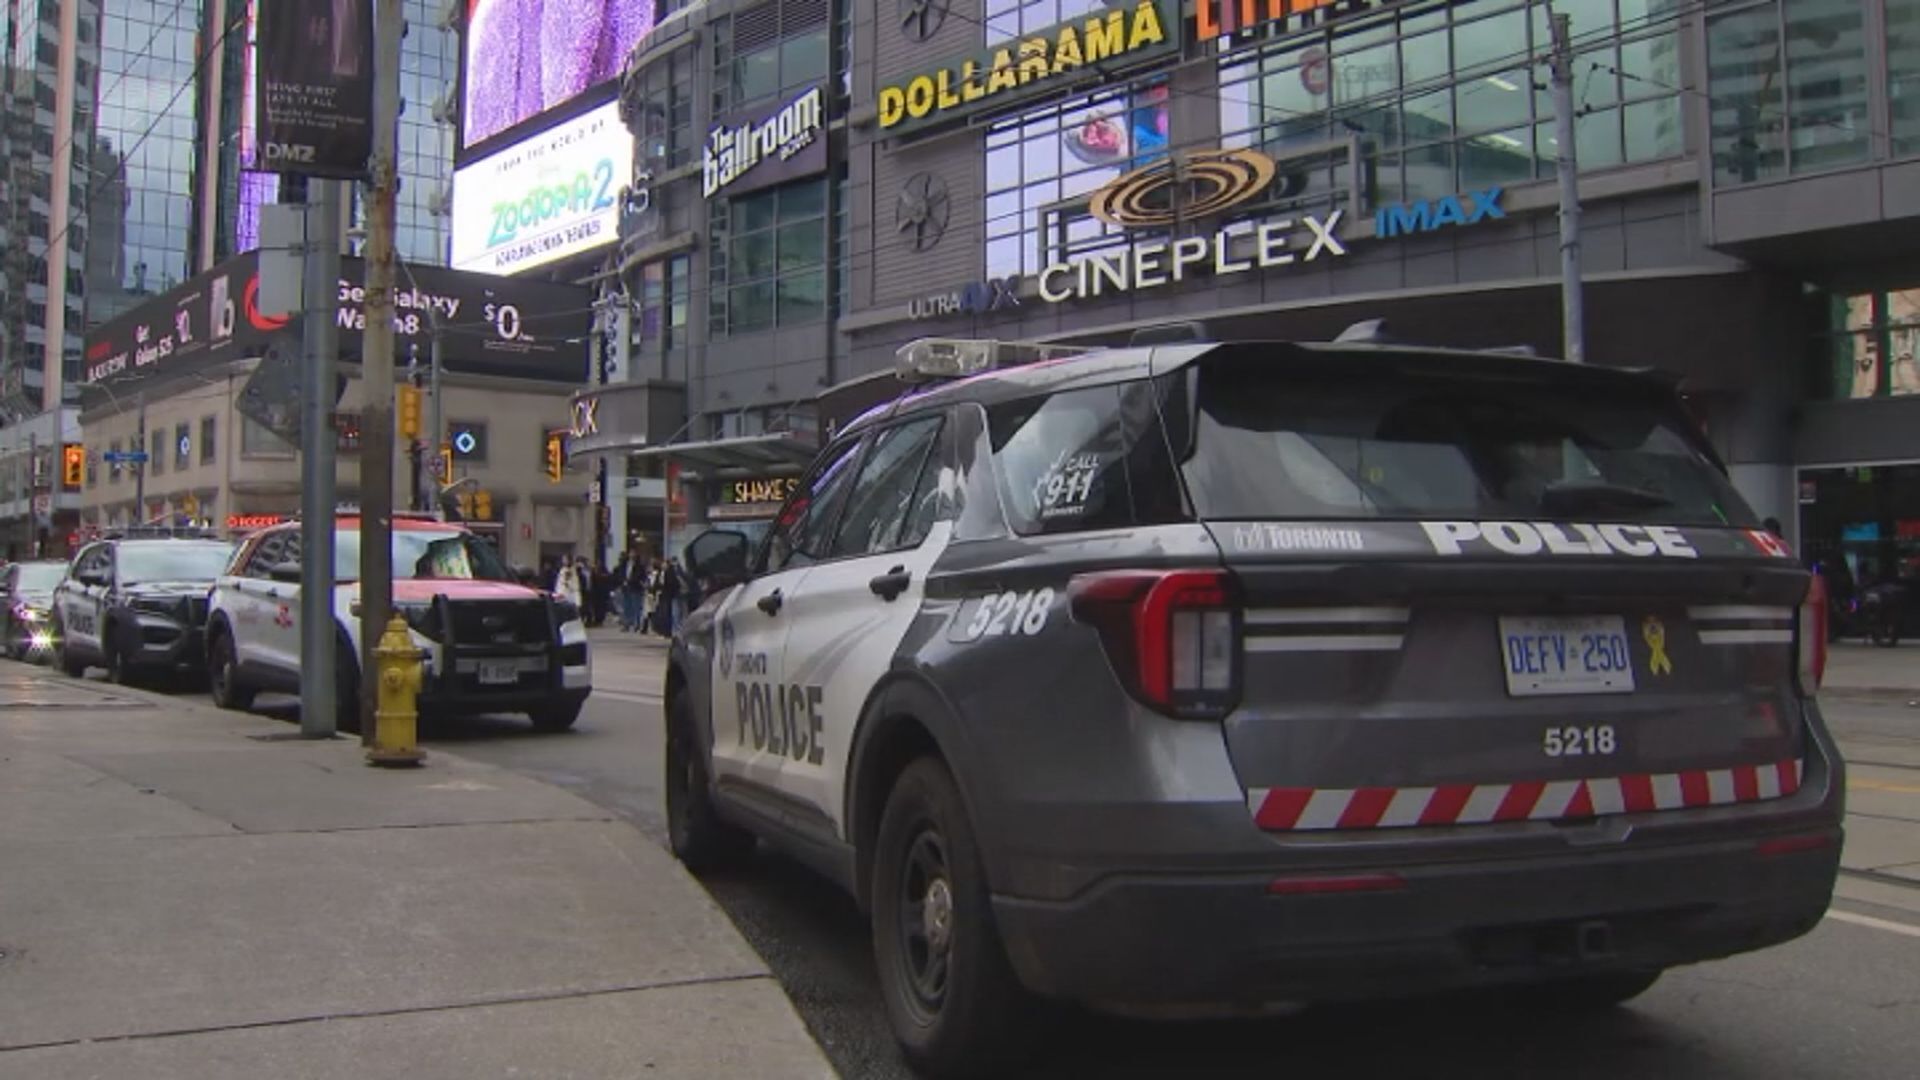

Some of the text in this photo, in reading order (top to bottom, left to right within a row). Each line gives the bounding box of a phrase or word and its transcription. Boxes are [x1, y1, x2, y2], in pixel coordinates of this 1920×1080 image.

[879, 0, 1164, 129] DOLLARAMA
[266, 142, 316, 163] DMZ
[590, 157, 615, 213] 2
[1374, 186, 1505, 240] IMAX
[1037, 209, 1347, 303] CINEPLEX
[735, 478, 785, 503] SHAKE
[1418, 520, 1699, 559] POLICE
[967, 586, 1056, 637] 5218
[735, 681, 825, 766] POLICE
[1543, 724, 1617, 757] 5218
